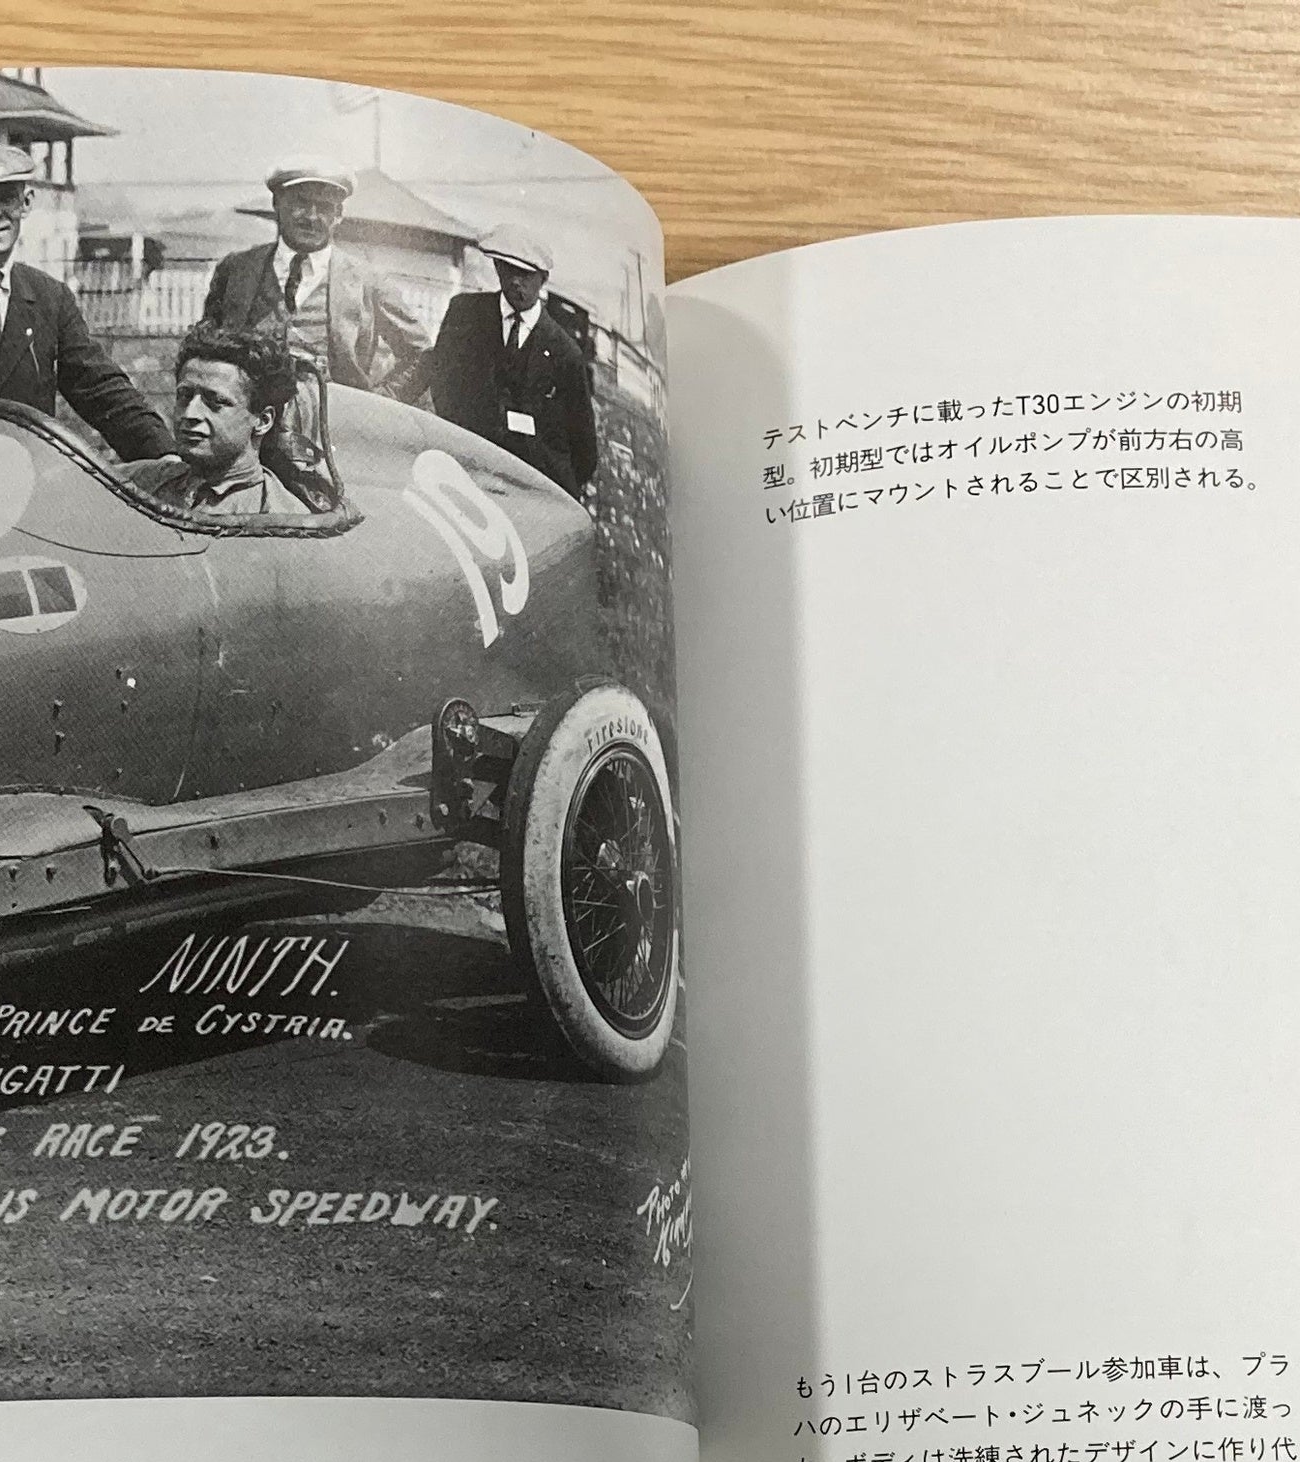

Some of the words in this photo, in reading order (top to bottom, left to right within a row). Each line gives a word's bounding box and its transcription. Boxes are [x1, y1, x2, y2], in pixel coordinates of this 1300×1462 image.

[763, 390, 1242, 450] テストベンチに載ったT30エンジンの初期
[763, 427, 1243, 490] 型。初期型ではオイルポンプが前方右の高
[766, 466, 1256, 524] い位置にマウントされることで区別される。
[401, 448, 530, 650] 19
[138, 932, 341, 998] NINTH.
[137, 1014, 175, 1034] DE
[33, 1123, 143, 1159] RACE
[174, 1121, 290, 1162] 1923.
[58, 1185, 230, 1222] MOTOR
[250, 1188, 499, 1235] SPEEDWAY.
[797, 1351, 1288, 1398] もう1台のストラスブール参加車は、プラ
[794, 1395, 1291, 1436] ハのエリザベート・ジュネックの手に渡っ
